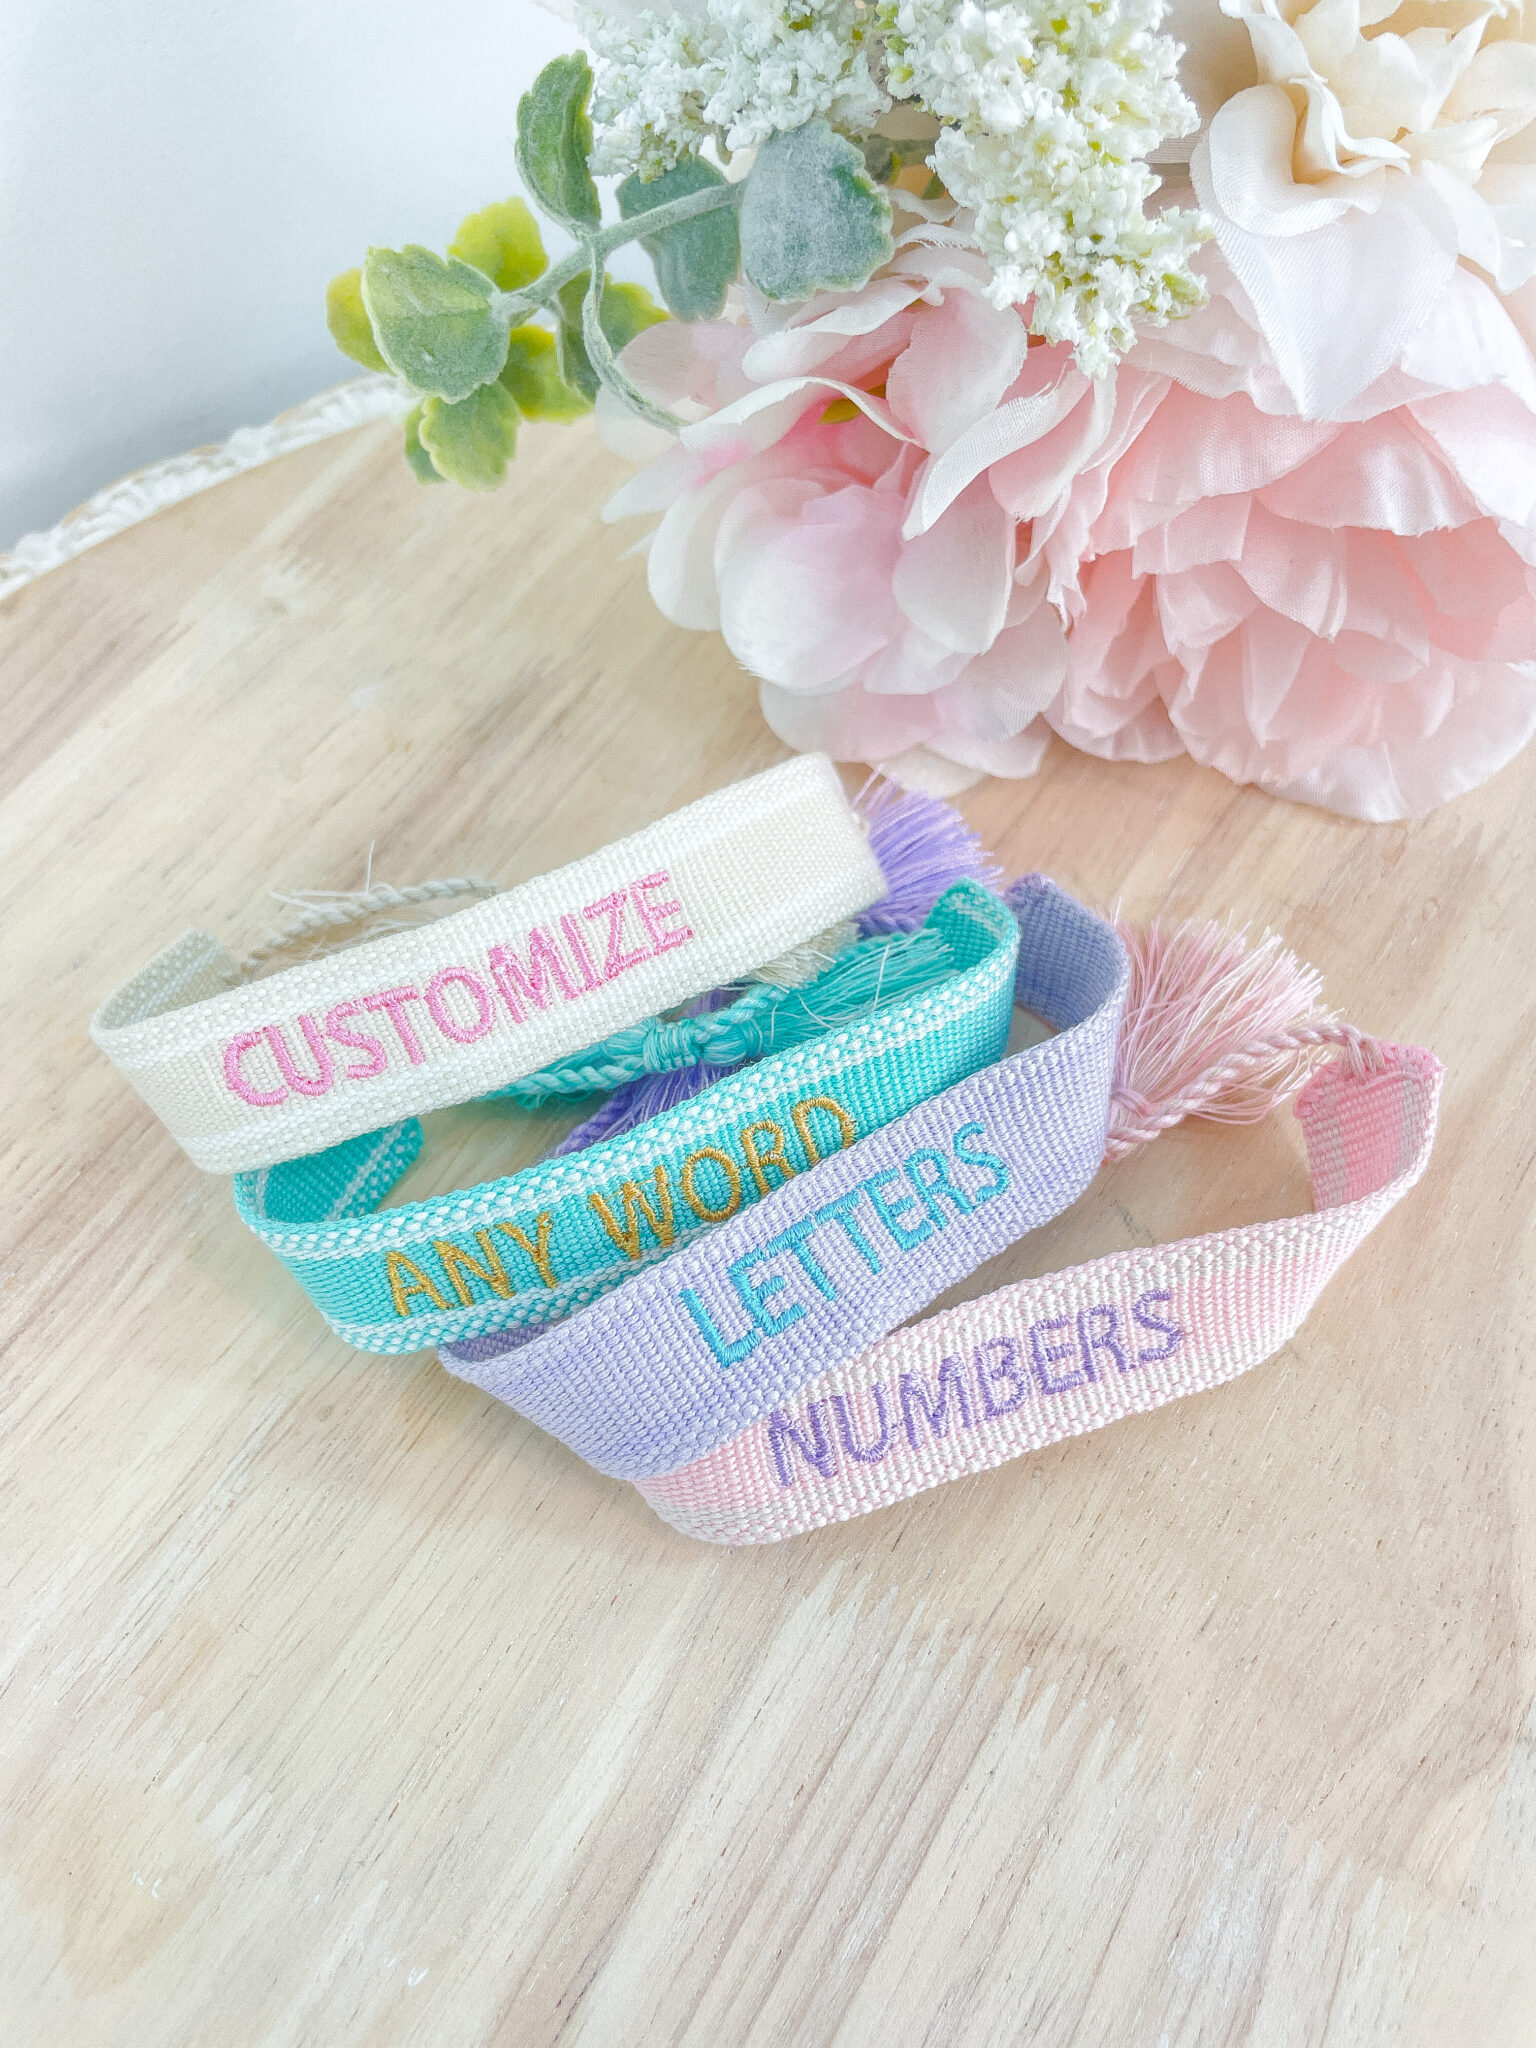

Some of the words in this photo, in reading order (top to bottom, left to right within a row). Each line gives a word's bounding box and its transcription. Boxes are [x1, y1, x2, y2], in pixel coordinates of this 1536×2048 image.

[222, 870, 694, 1106] CUSTOMIZE
[385, 1212, 558, 1316] ANY
[589, 1096, 856, 1261] WORD
[678, 1121, 1012, 1368] LETTERS
[766, 1289, 1186, 1487] NUMBERS
